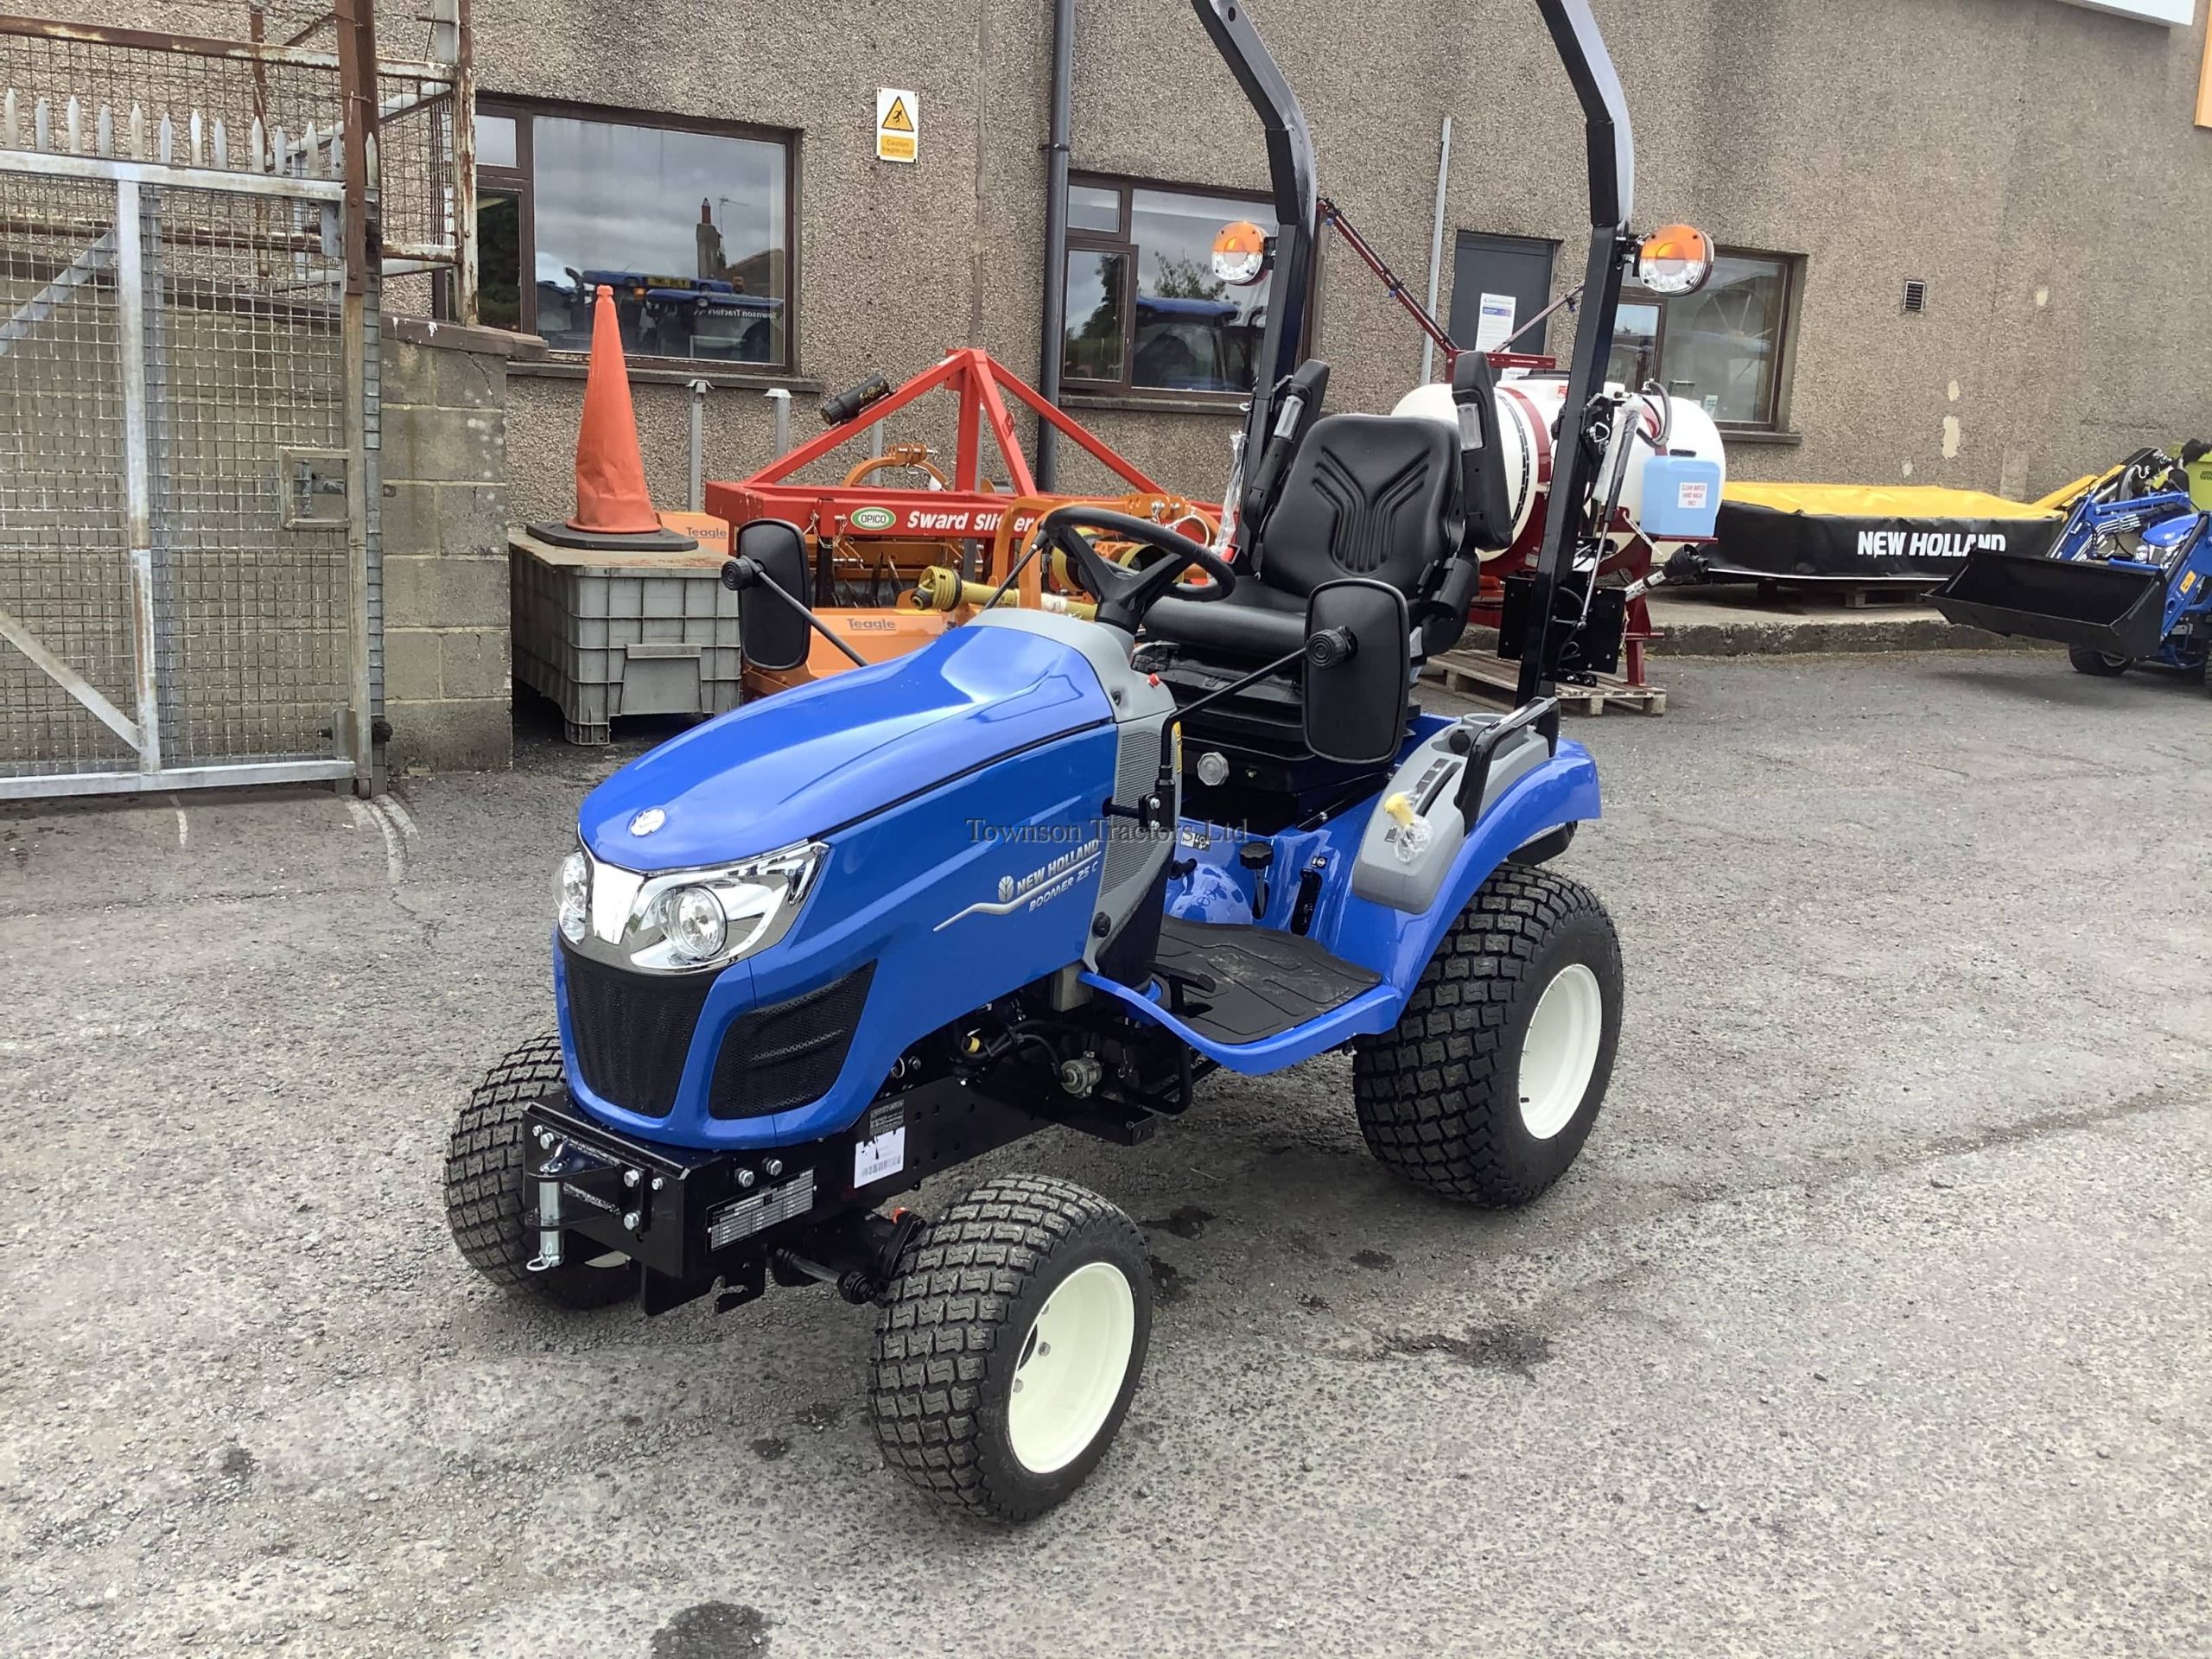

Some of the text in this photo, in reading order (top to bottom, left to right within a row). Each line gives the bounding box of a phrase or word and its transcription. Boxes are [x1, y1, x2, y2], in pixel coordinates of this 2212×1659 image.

[861, 513, 887, 524] OPICO
[907, 511, 1035, 532] Sward Sliter
[686, 527, 727, 538] Teagle
[1858, 531, 1907, 556] NEW
[846, 618, 896, 631] Teagle
[1017, 839, 1099, 895] NEW HOLLAND
[1029, 861, 1099, 912] BOOMER 25 C
